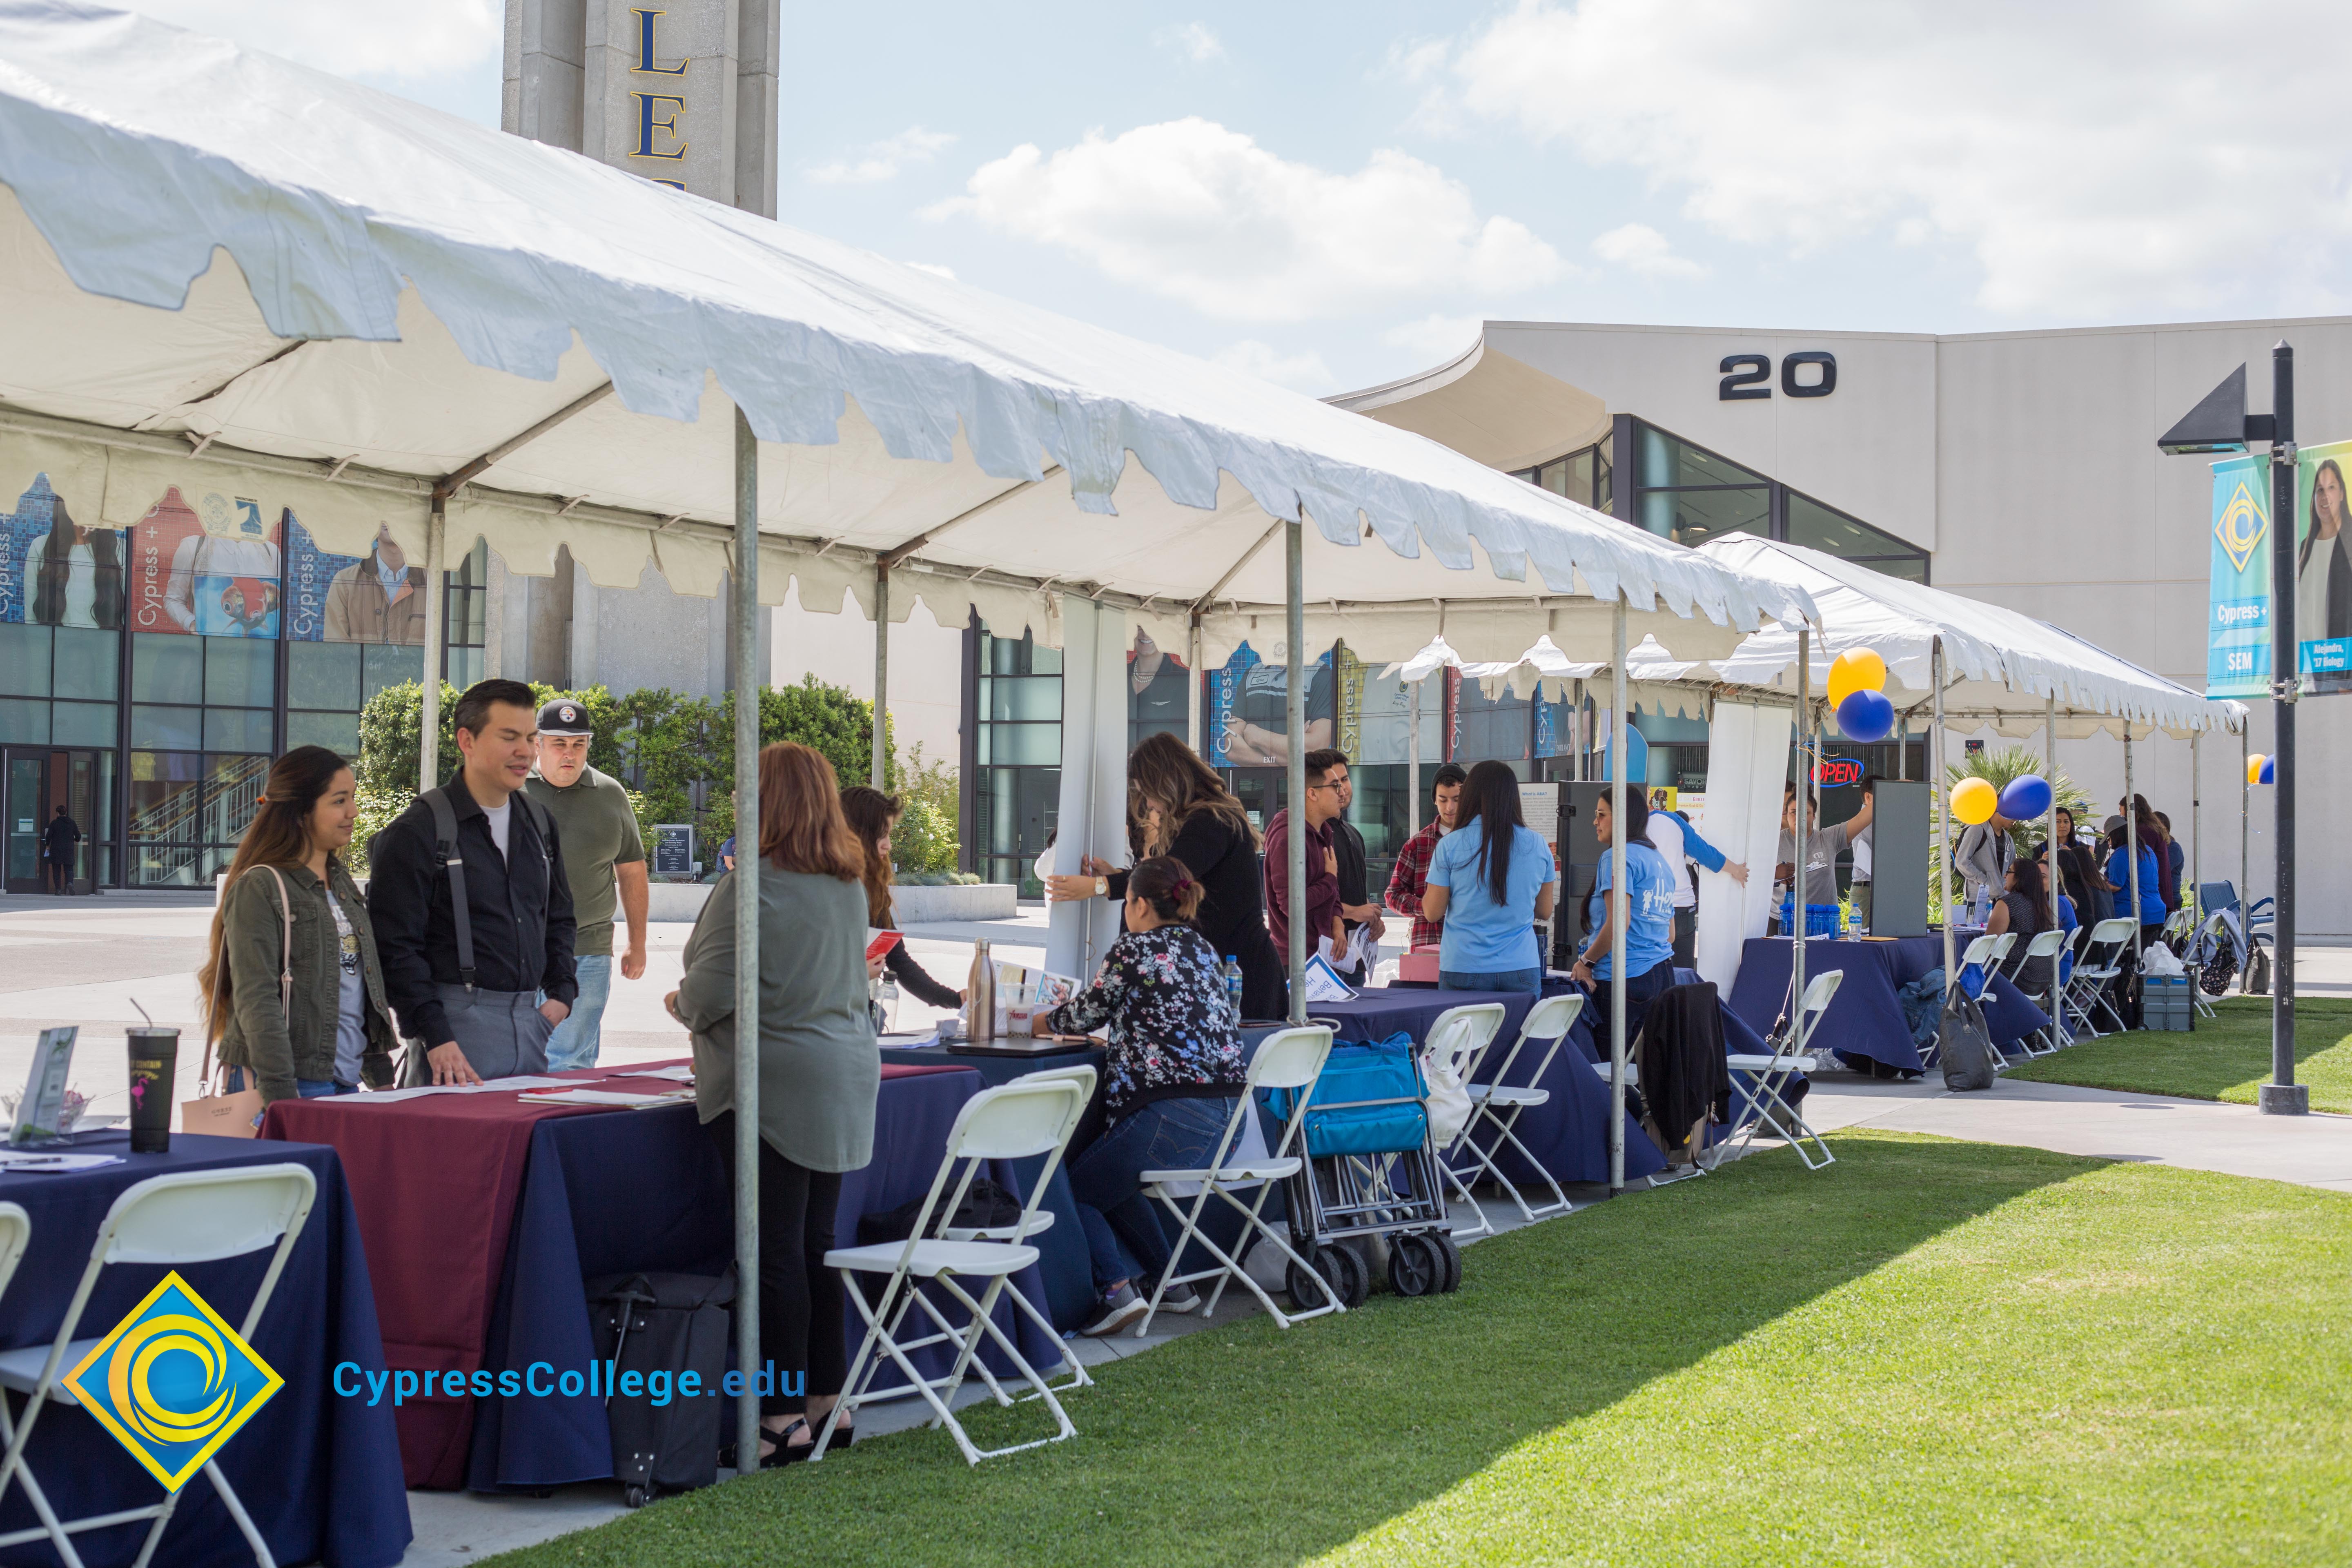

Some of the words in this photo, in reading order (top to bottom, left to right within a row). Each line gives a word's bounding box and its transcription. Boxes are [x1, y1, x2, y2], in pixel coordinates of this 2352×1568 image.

[628, 8, 689, 190] LE
[1719, 351, 1837, 401] 20
[138, 546, 163, 626] Cypress
[293, 554, 318, 635] Cypress
[2218, 604, 2259, 625] Cypress
[2228, 652, 2252, 670] SEM
[2313, 643, 2344, 655] Alejandra,
[2323, 656, 2345, 668] Biology
[1216, 668, 1236, 753] Cypress
[1341, 677, 1356, 753] Cypress
[1451, 677, 1462, 748] Cypress
[1810, 764, 1859, 782] OPEN
